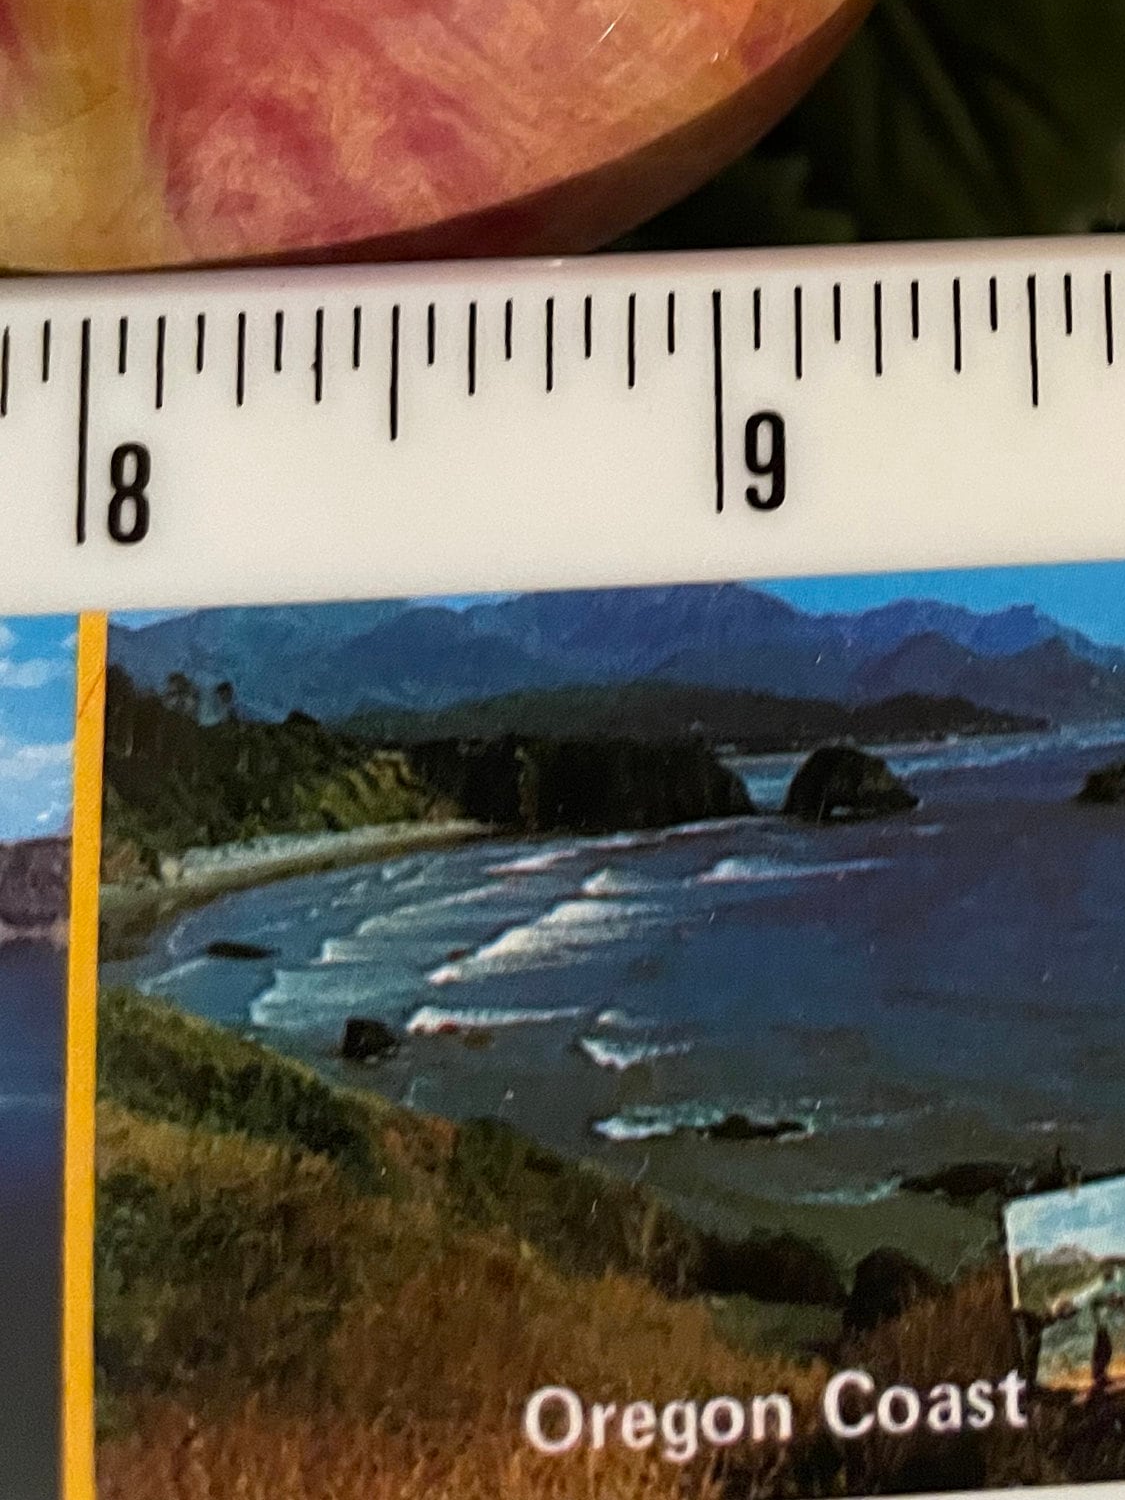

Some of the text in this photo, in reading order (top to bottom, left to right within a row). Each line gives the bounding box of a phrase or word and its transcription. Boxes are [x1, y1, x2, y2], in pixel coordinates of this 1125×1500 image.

[106, 441, 152, 545] 8
[743, 410, 787, 512] 9
[523, 1368, 1029, 1463] Oregon Coast
